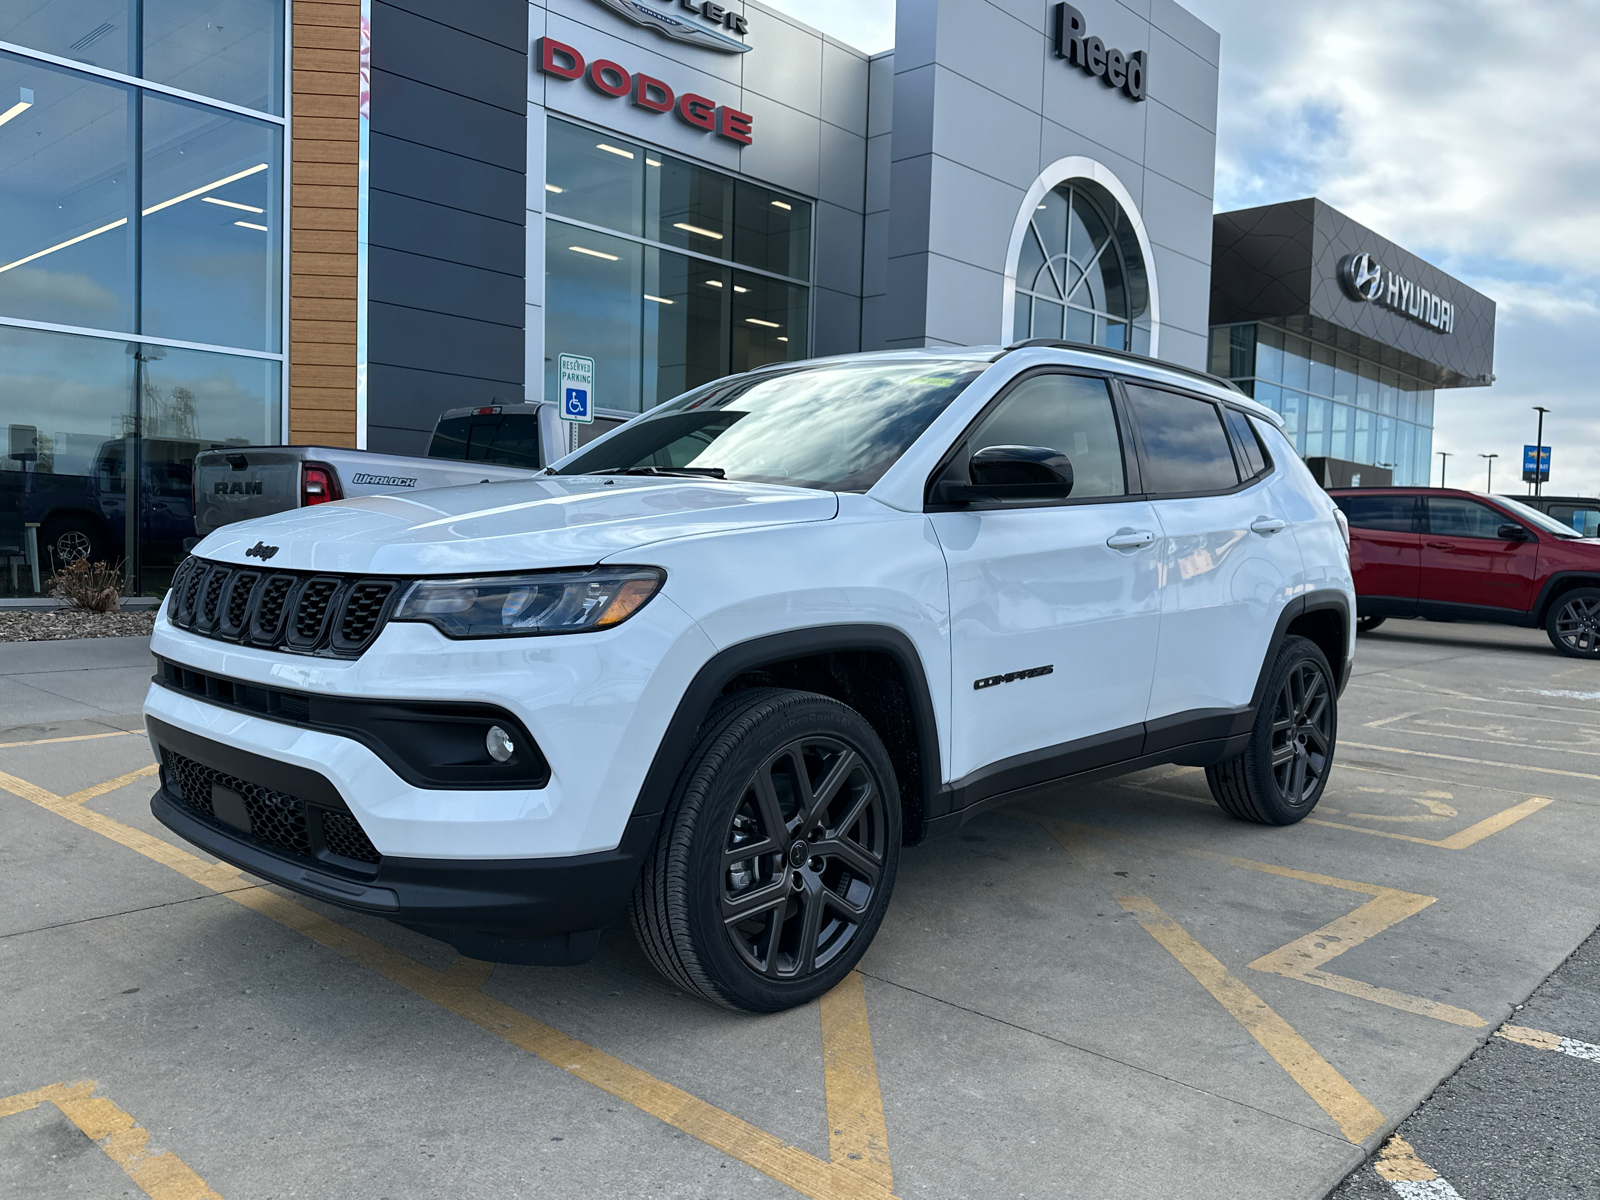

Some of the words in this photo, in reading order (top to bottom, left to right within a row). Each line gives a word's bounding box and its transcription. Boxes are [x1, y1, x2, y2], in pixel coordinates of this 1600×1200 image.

[636, 5, 677, 26] CHRYSLER
[1055, 1, 1147, 102] Reed
[537, 36, 753, 145] DODGE
[1386, 270, 1455, 334] HYUNDAI
[562, 360, 591, 373] RESERVED
[562, 371, 591, 384] PARKING
[214, 481, 263, 495] RAM
[352, 472, 417, 488] WARLOCK
[245, 540, 279, 562] Jeep
[973, 664, 1054, 690] COMPASS
